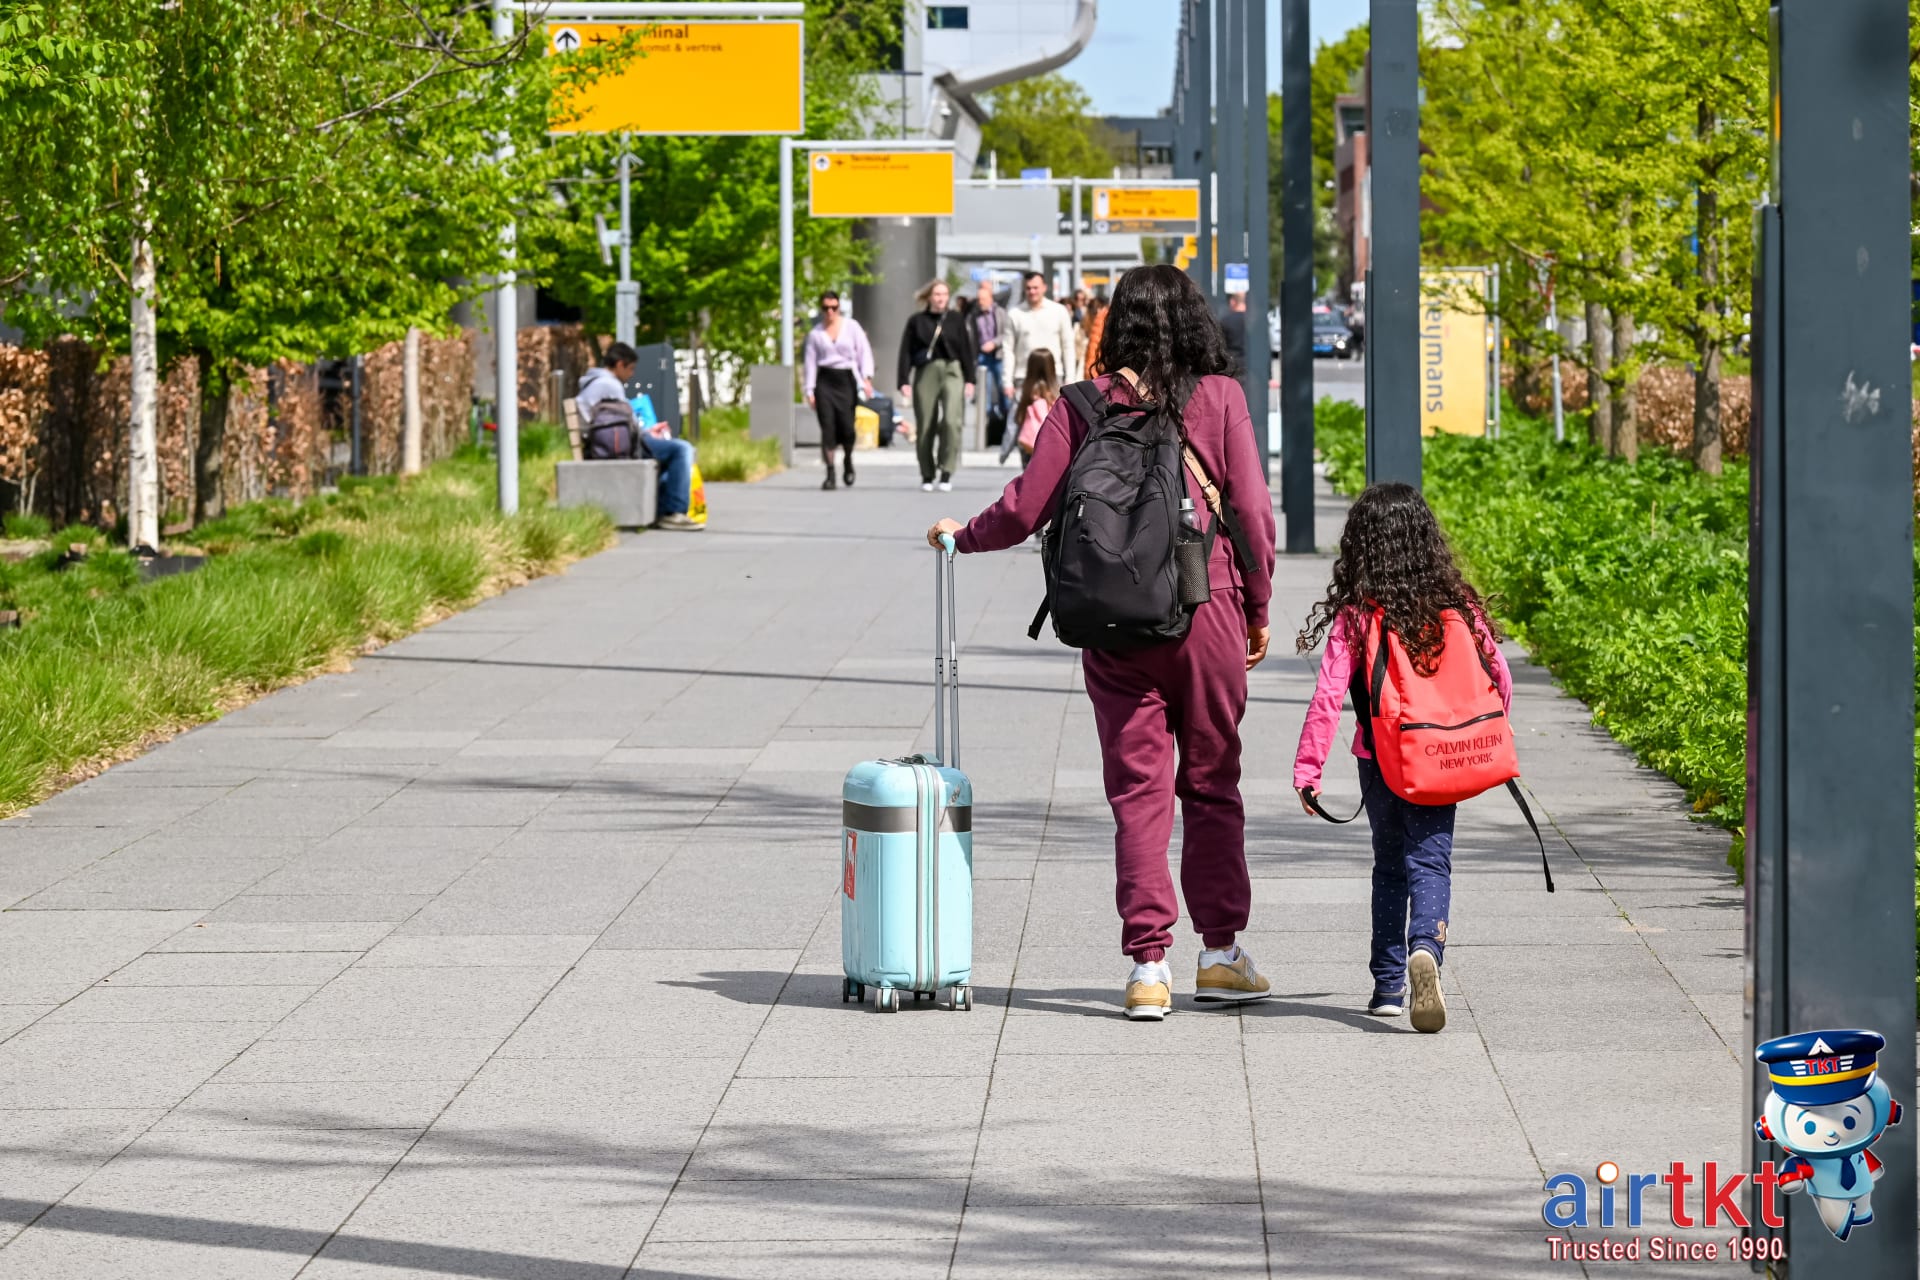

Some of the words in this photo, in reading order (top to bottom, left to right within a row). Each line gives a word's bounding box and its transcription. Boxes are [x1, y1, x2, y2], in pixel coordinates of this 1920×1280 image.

[617, 24, 689, 38] Teinal
[686, 43, 723, 52] vertrek
[1424, 739, 1471, 757] CALVIN
[1473, 733, 1503, 750] KLEIN
[1440, 756, 1465, 770] NEW
[1466, 752, 1494, 767] YORK
